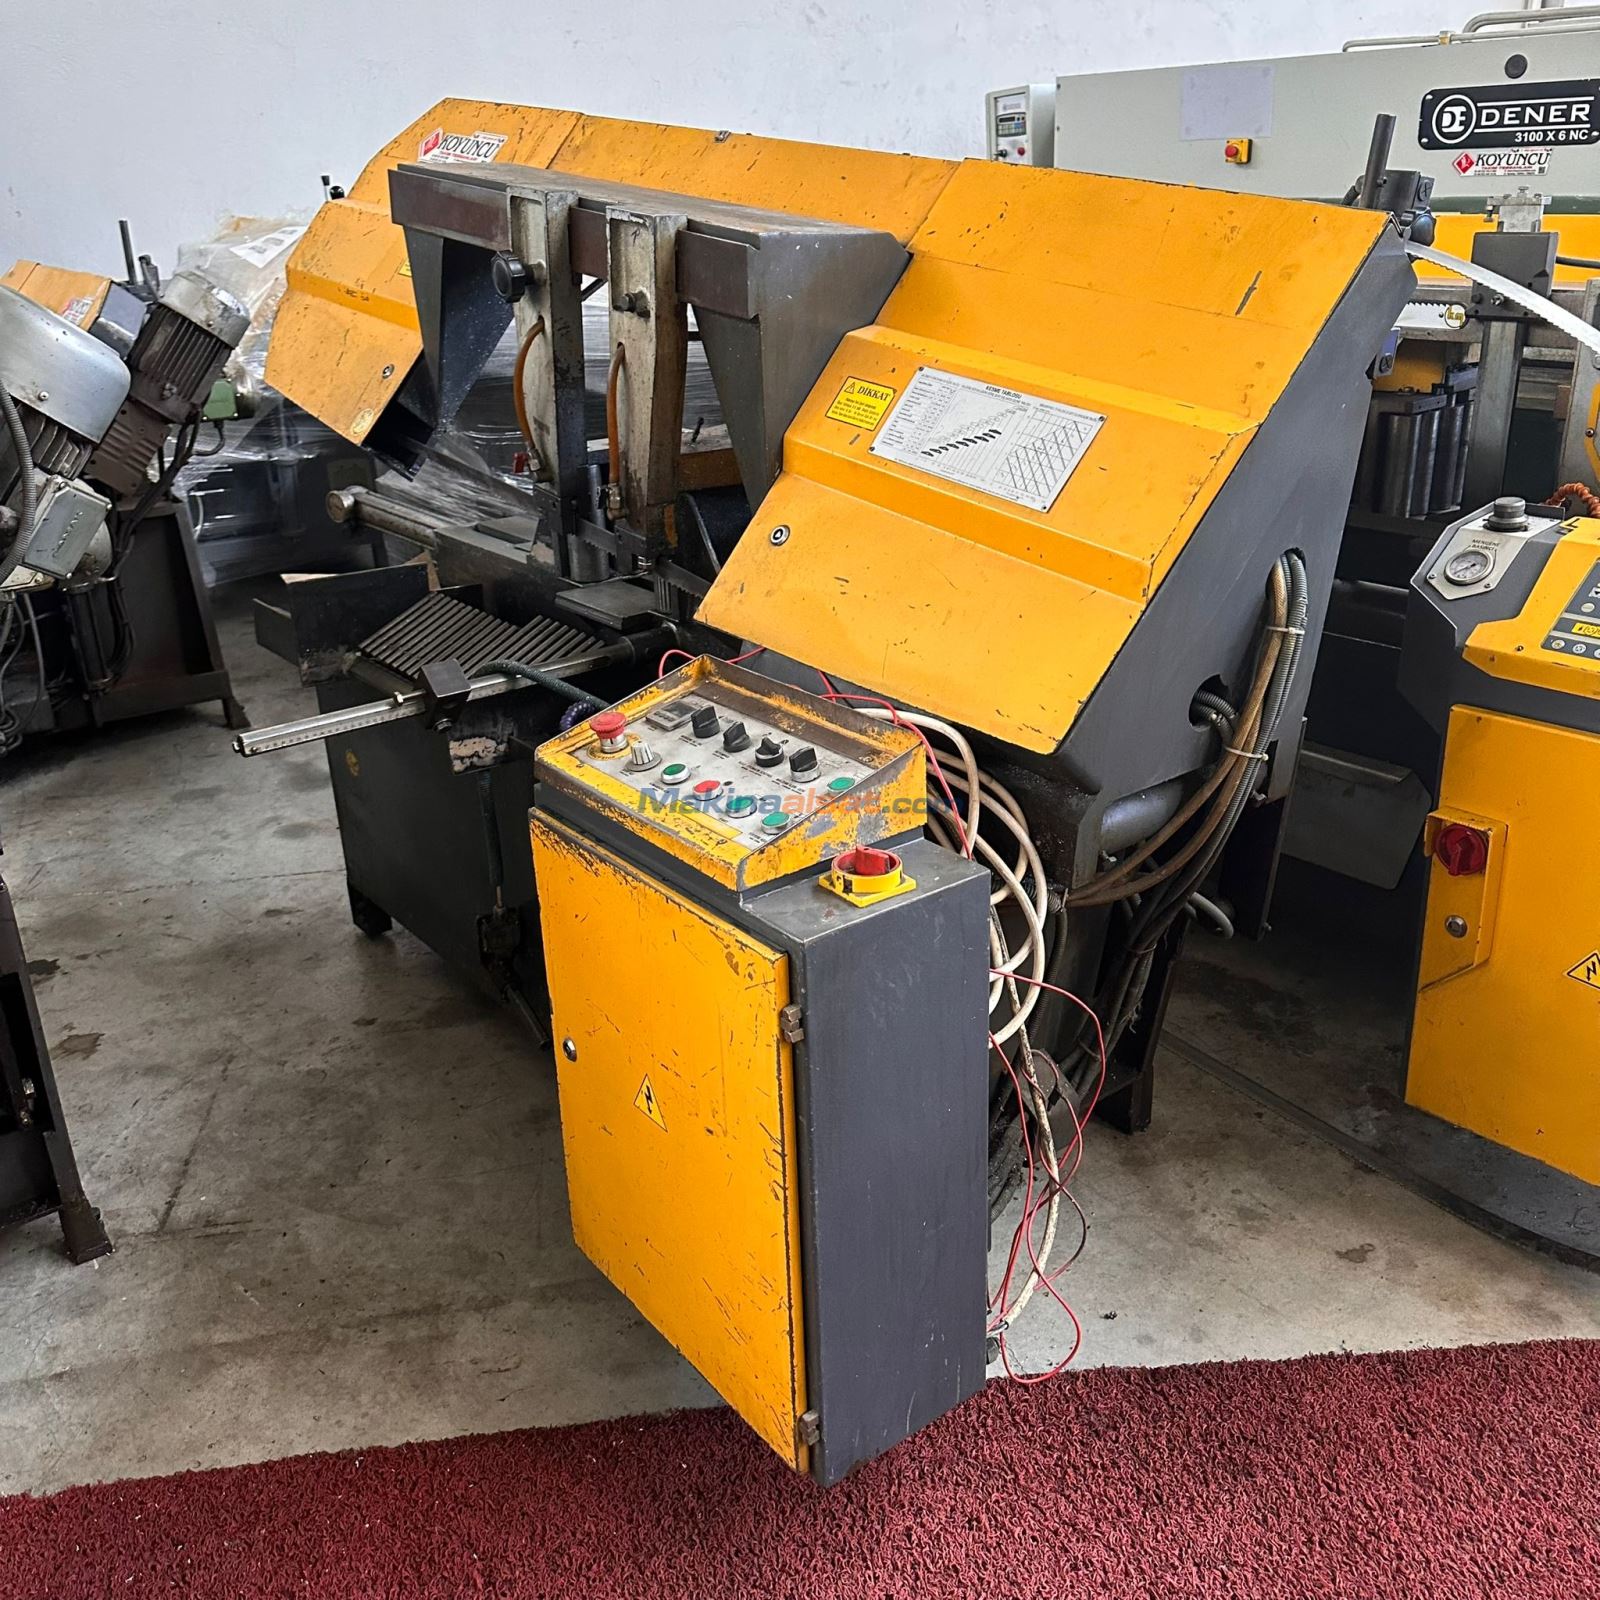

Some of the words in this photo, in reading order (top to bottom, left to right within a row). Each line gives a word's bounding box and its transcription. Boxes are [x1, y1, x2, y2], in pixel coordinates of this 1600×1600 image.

[1480, 103, 1591, 126] DENER
[1514, 131, 1544, 142] 3100
[1545, 130, 1556, 141] X
[1558, 130, 1567, 140] 6
[1569, 129, 1589, 140] NC
[437, 135, 500, 158] KOYUNCU
[1475, 152, 1551, 167] KOYUNCU
